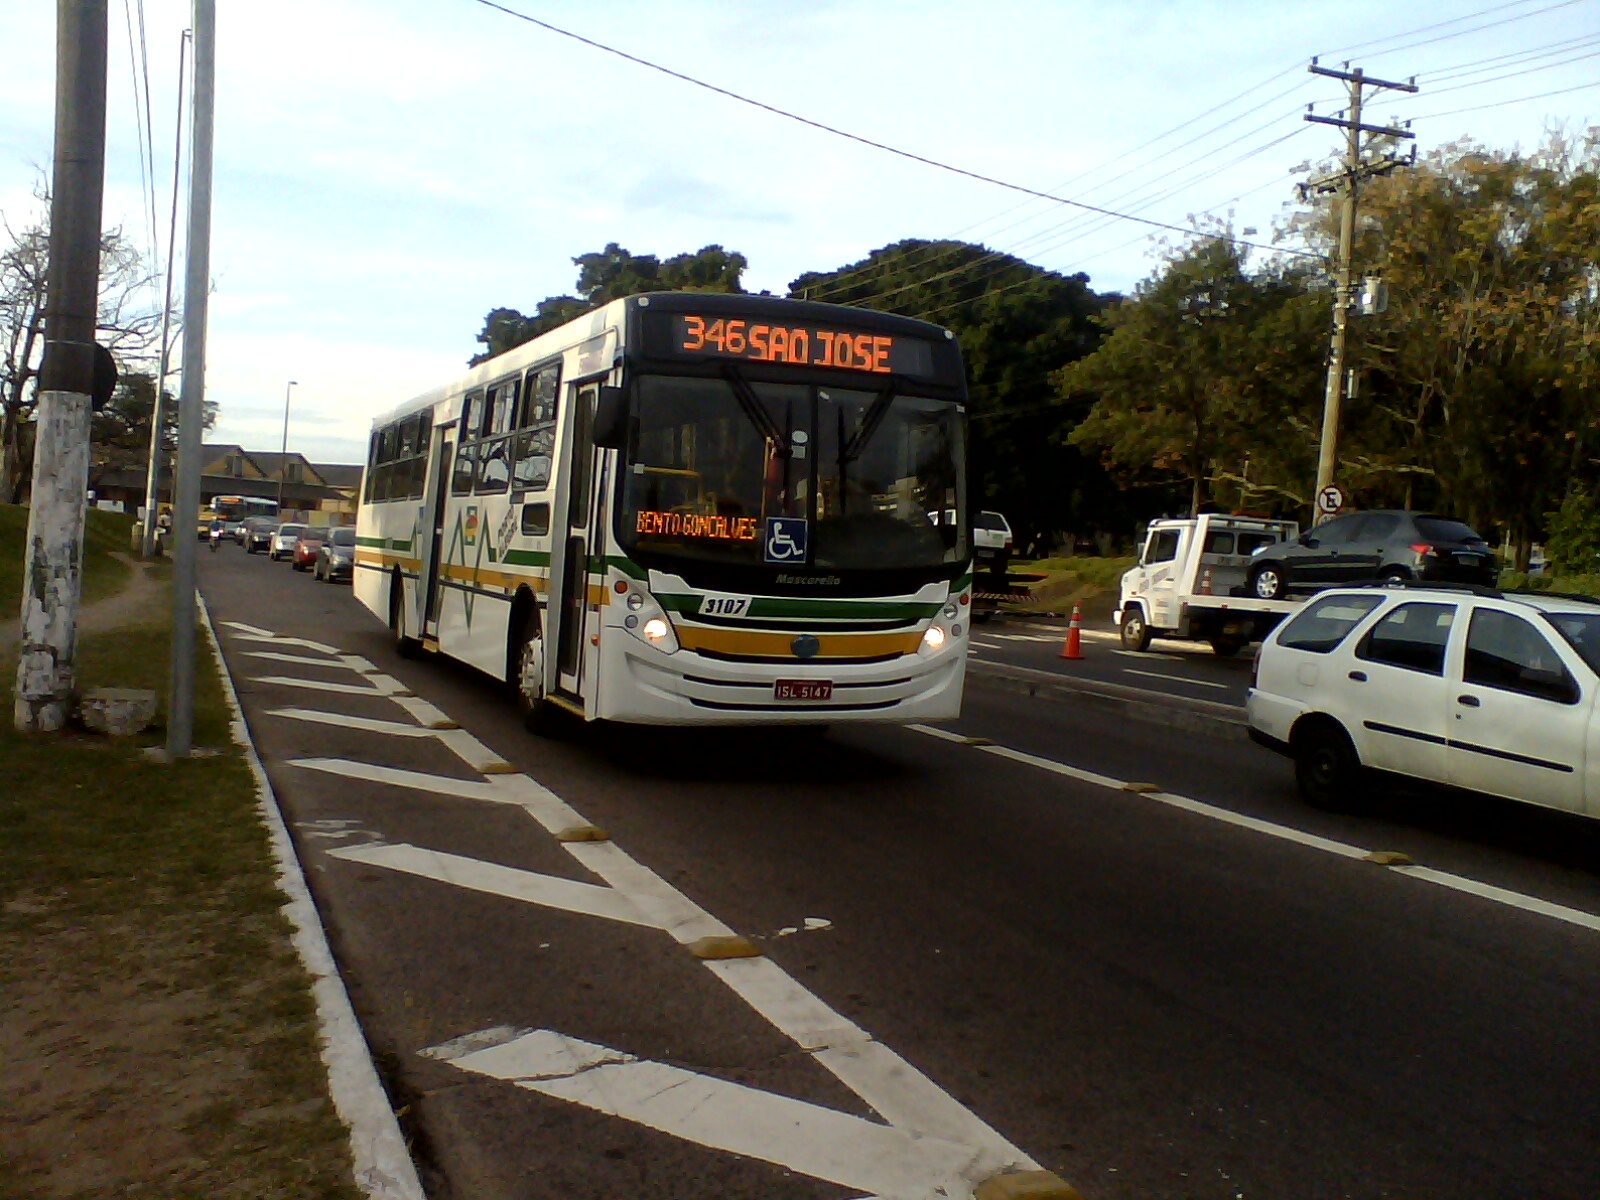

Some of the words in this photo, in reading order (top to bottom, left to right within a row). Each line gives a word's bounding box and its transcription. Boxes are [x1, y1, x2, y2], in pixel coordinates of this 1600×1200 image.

[683, 315, 747, 354] 346
[748, 324, 809, 364] SAO
[813, 331, 893, 373] JOSE
[636, 510, 681, 536] BENTO
[682, 513, 757, 540] GONCALVES
[705, 598, 746, 615] 3107
[801, 686, 830, 698] 5147
